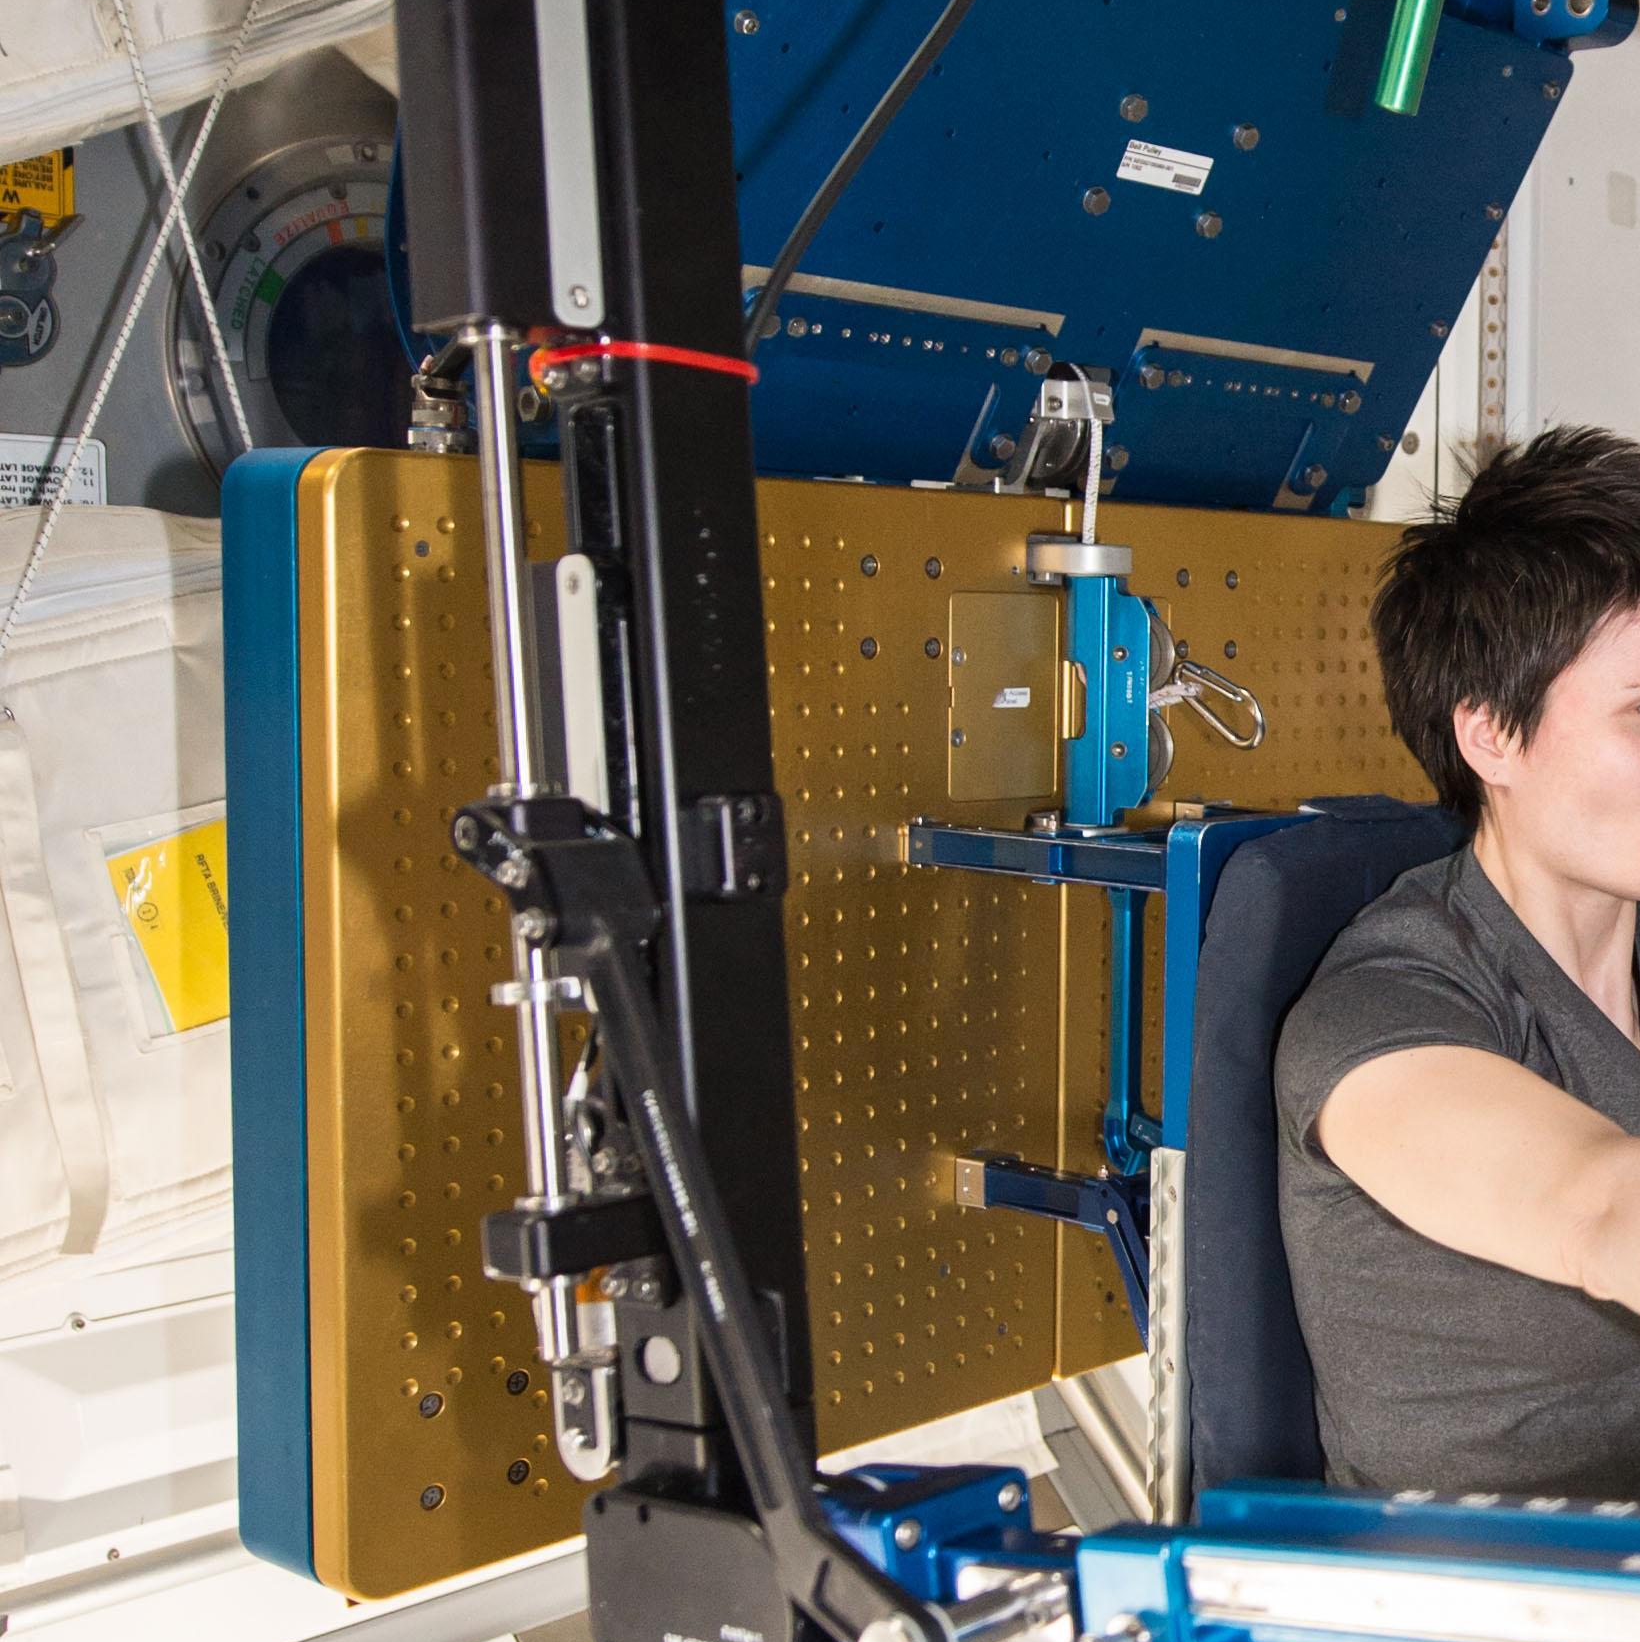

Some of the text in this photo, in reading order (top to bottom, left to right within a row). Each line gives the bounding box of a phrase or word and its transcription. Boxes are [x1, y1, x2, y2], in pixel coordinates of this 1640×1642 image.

[272, 201, 349, 246] EQUALIZE
[231, 255, 266, 330] LATCHED
[196, 853, 211, 879] RFTA
